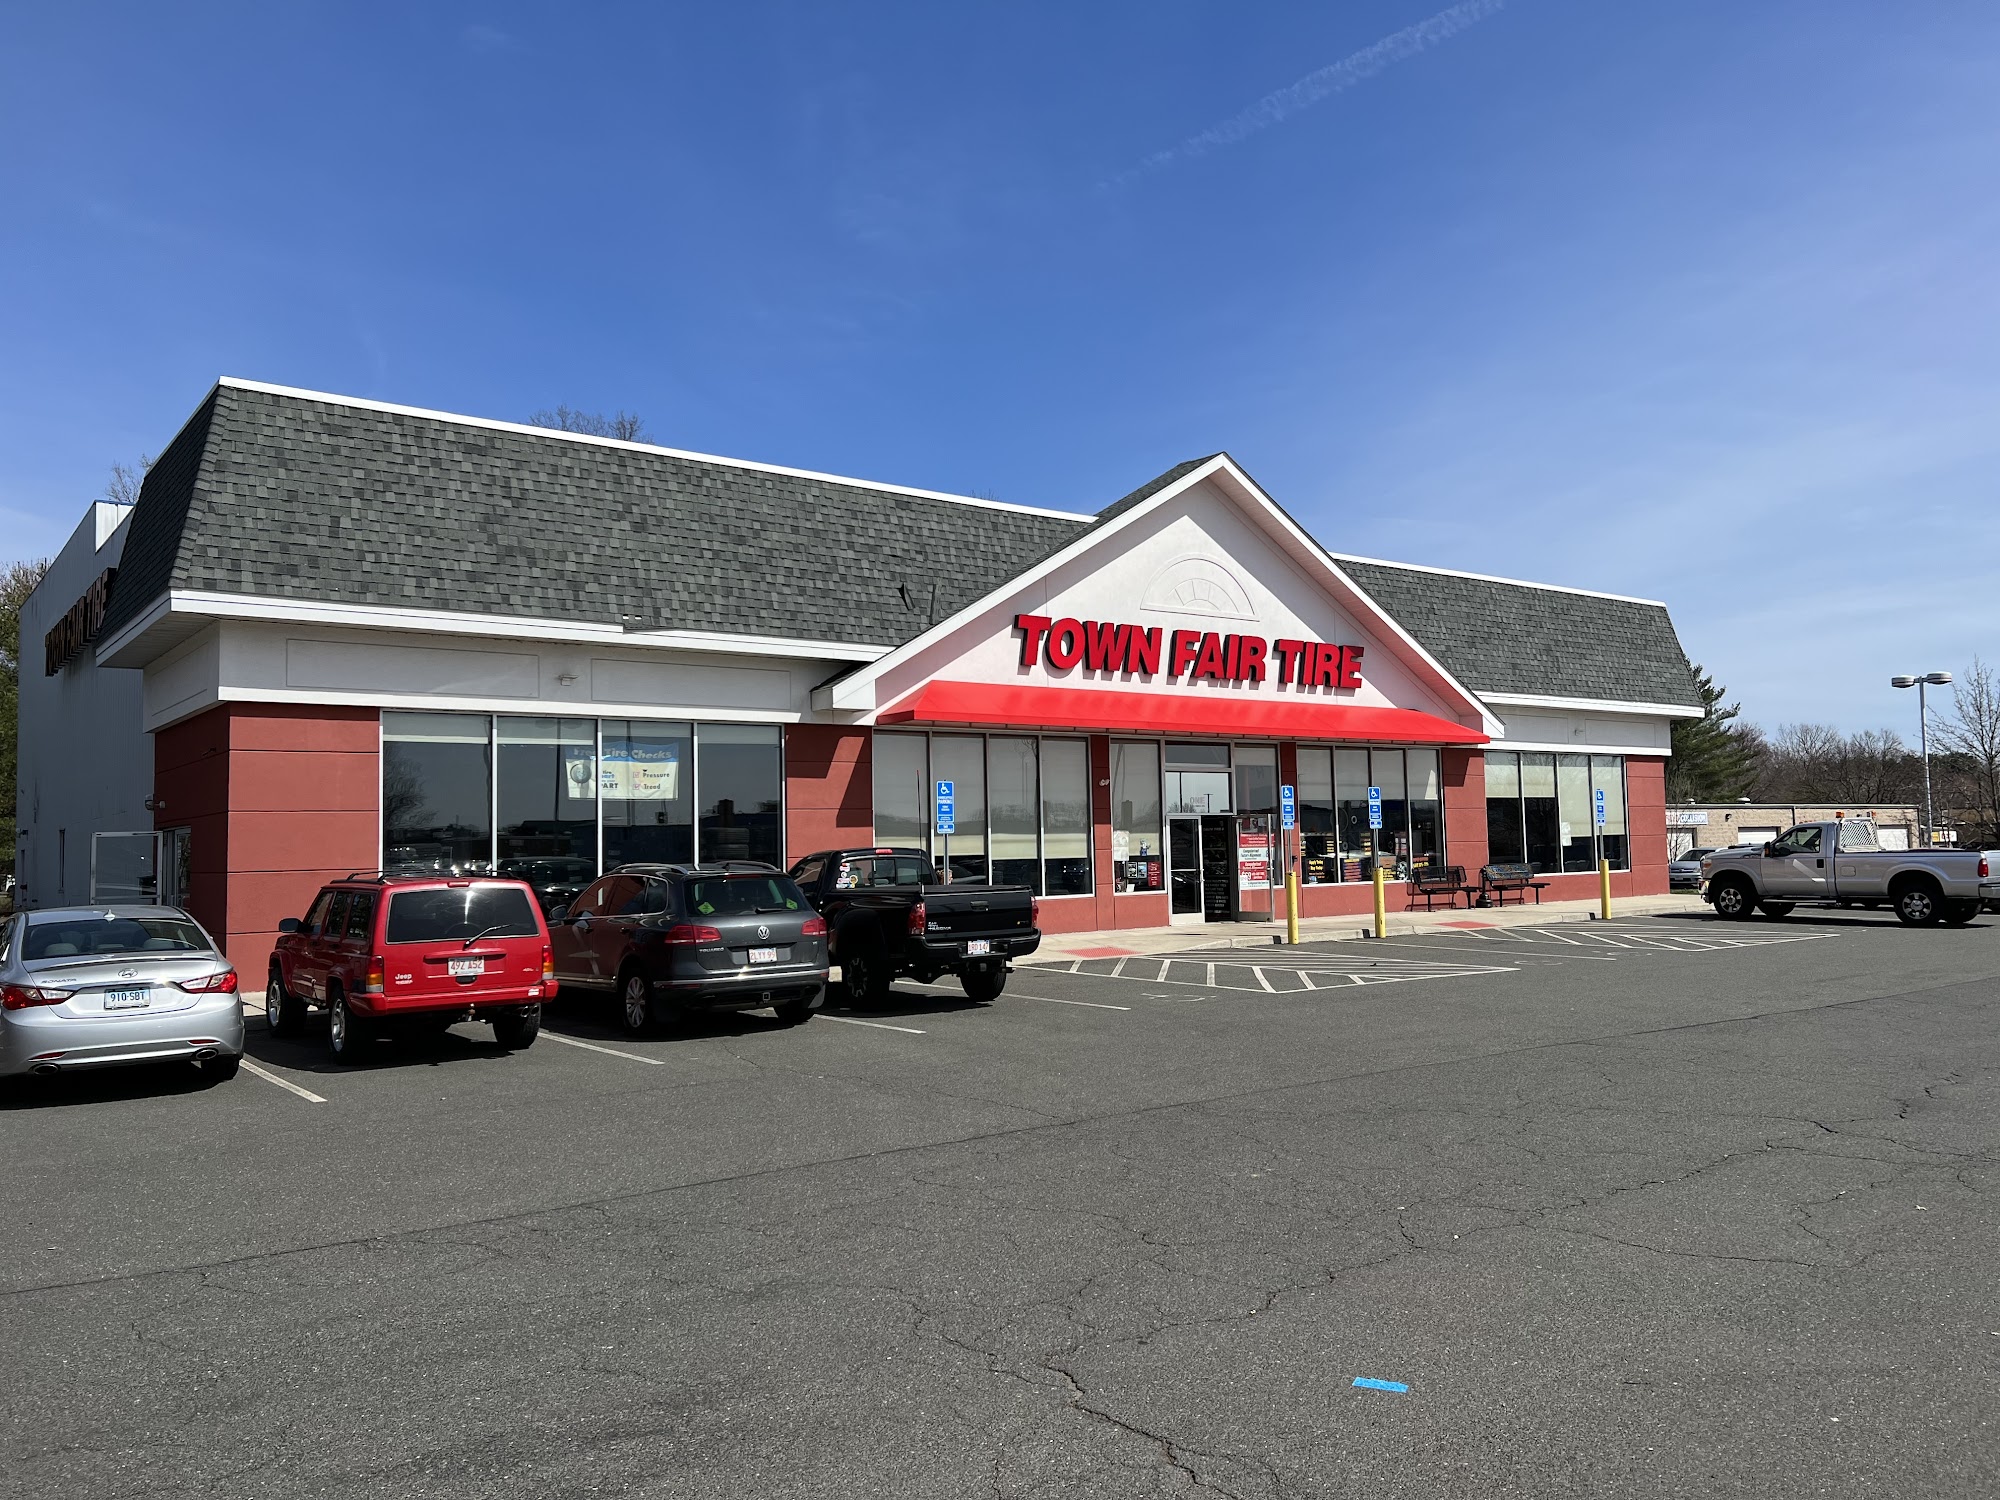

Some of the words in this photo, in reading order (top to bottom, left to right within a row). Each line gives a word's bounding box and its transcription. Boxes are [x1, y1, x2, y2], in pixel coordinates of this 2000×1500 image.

[1014, 613, 1163, 675] TOWN
[1172, 629, 1267, 682] FAIR
[1274, 638, 1365, 689] TIRE
[604, 748, 628, 757] Tire
[631, 749, 672, 759] Checks
[110, 991, 145, 1002] 910-SBT
